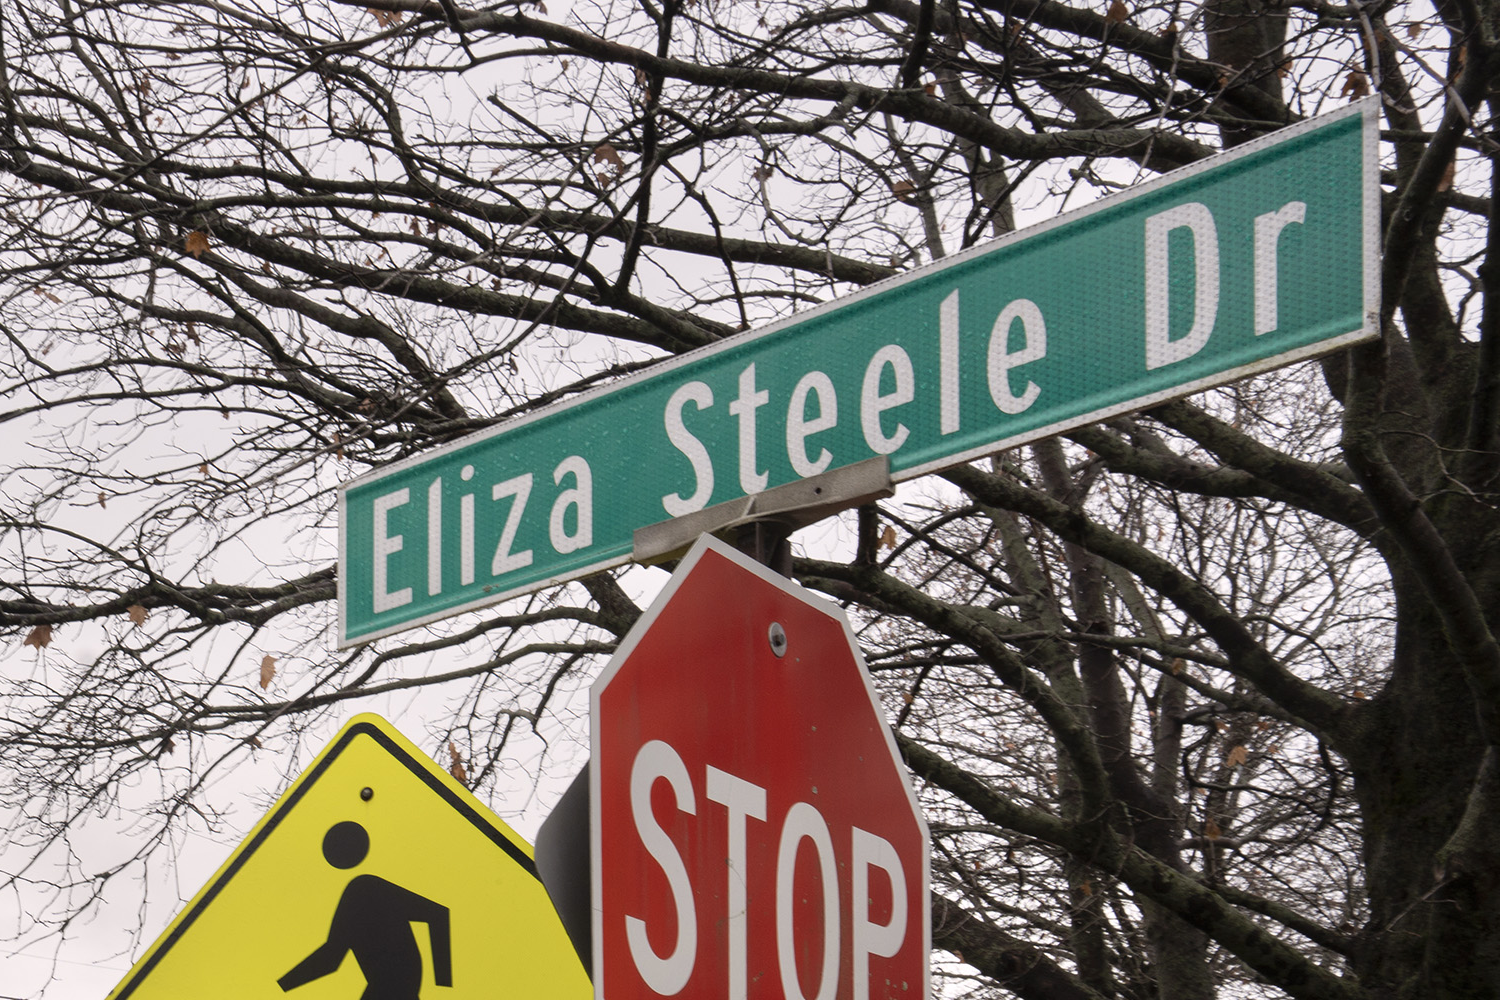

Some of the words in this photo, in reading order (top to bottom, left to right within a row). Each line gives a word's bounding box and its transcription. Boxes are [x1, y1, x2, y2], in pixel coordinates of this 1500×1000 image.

[371, 454, 594, 614] Eliza
[661, 287, 1048, 518] Steele
[1144, 200, 1307, 371] Dr
